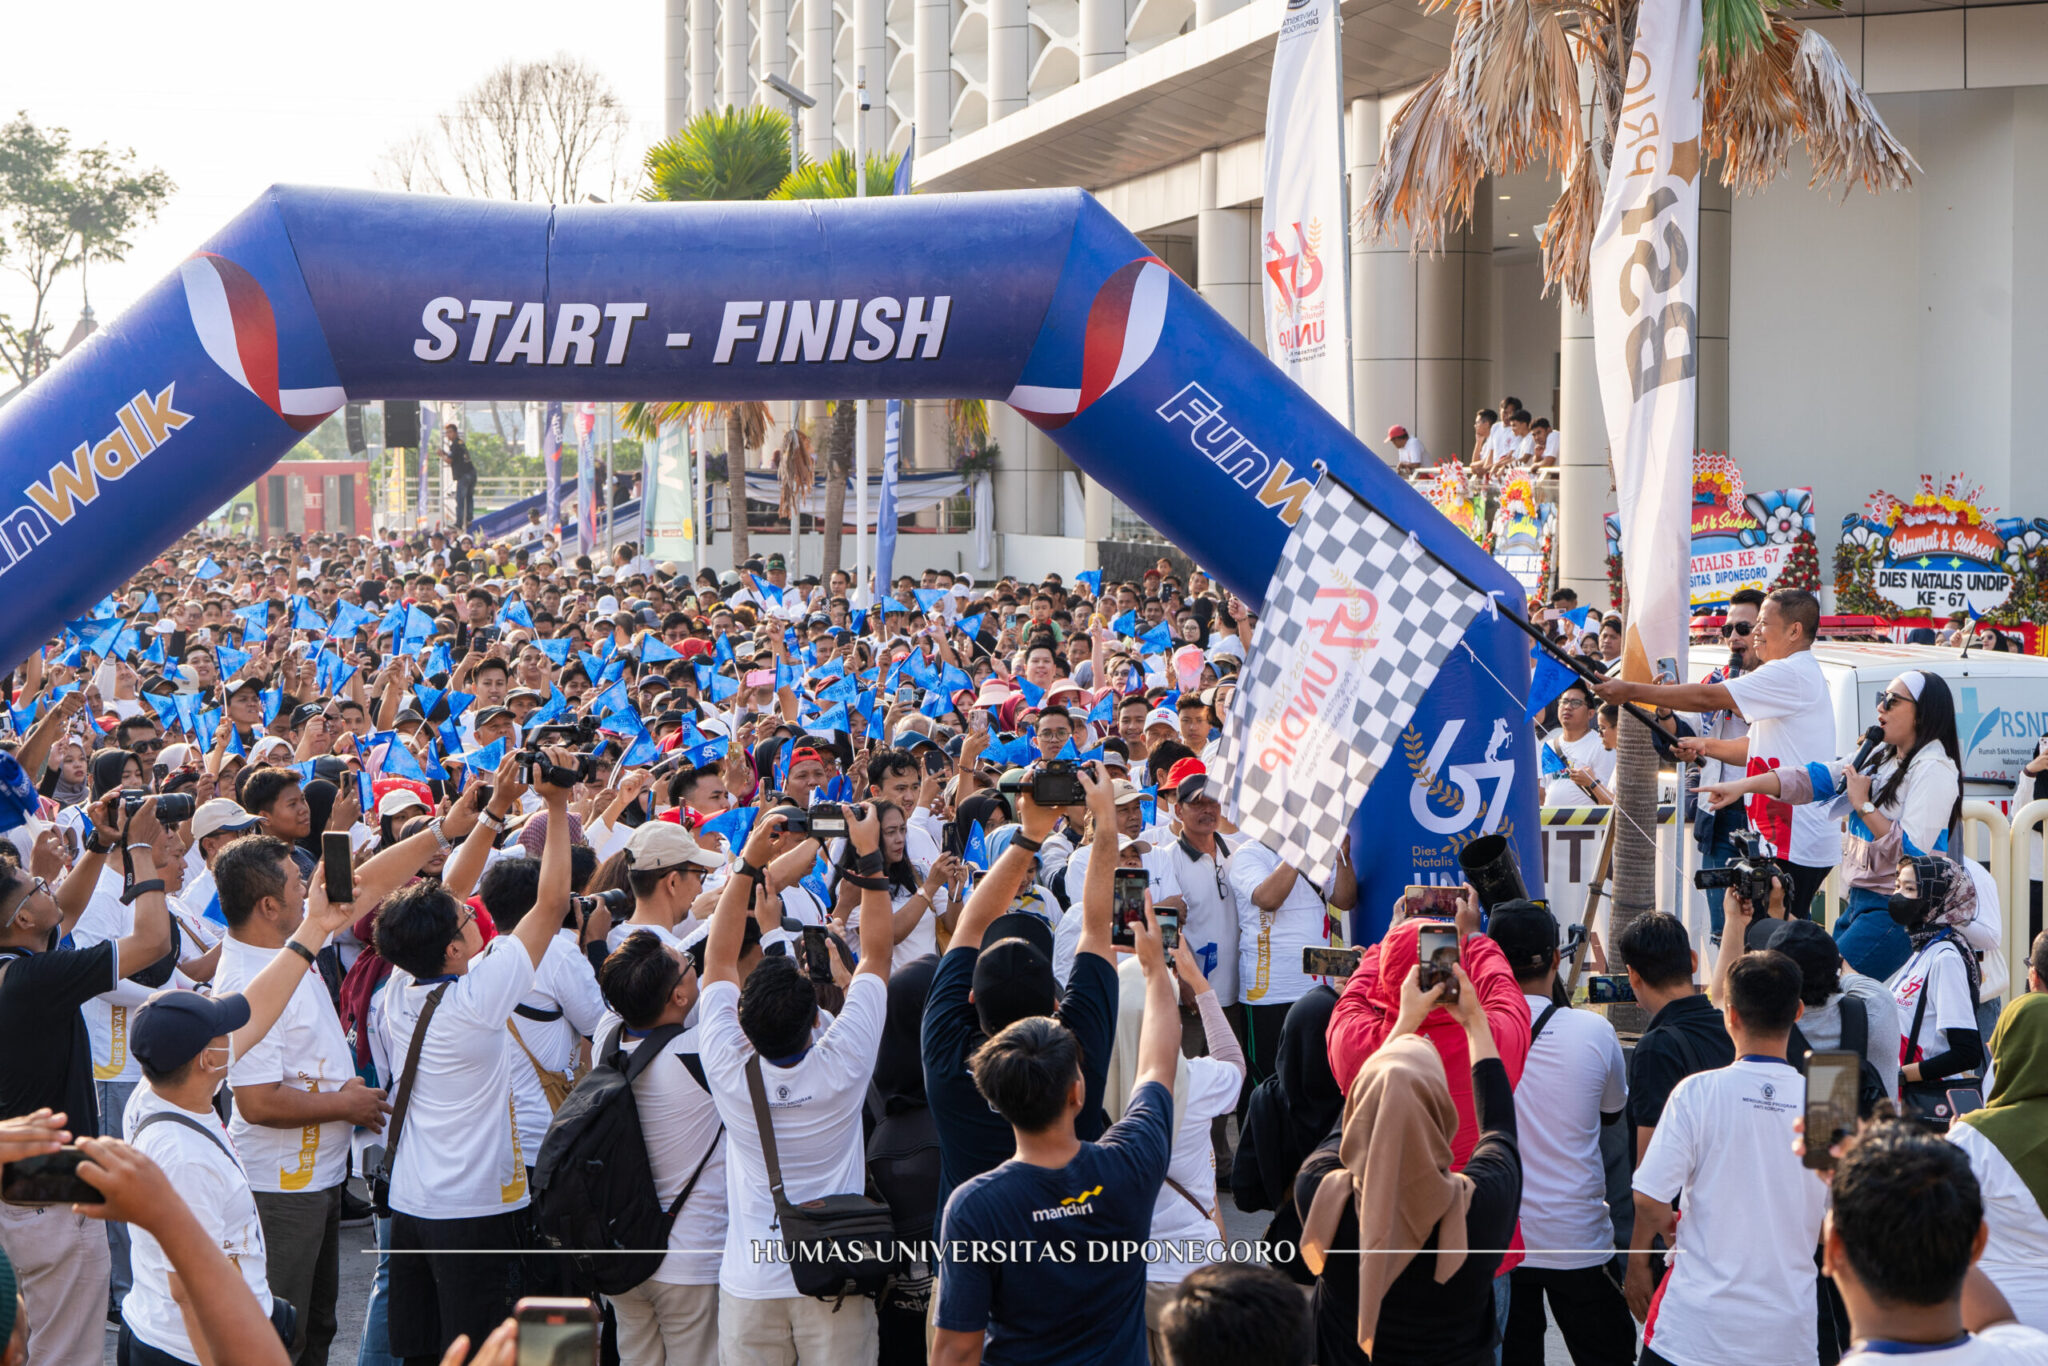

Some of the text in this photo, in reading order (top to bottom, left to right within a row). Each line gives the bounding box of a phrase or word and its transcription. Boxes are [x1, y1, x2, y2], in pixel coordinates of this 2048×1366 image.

[413, 295, 952, 367] START - FINISH
[1889, 527, 1996, 562] Selamat & Sukses
[1690, 554, 1733, 574] ATALIS
[1690, 566, 1768, 588] SITAS DIPONEGORO
[1879, 571, 2010, 592] DIES NATALIS UNDIP
[1917, 591, 1937, 606] KE
[1948, 592, 1966, 607] 67
[1409, 718, 1515, 837] 67
[1412, 845, 1438, 857] Dies
[1413, 856, 1454, 868] Natalis
[1896, 998, 1913, 1007] NDIP
[113, 1041, 124, 1066] DIES
[1032, 1202, 1094, 1222] mandiri
